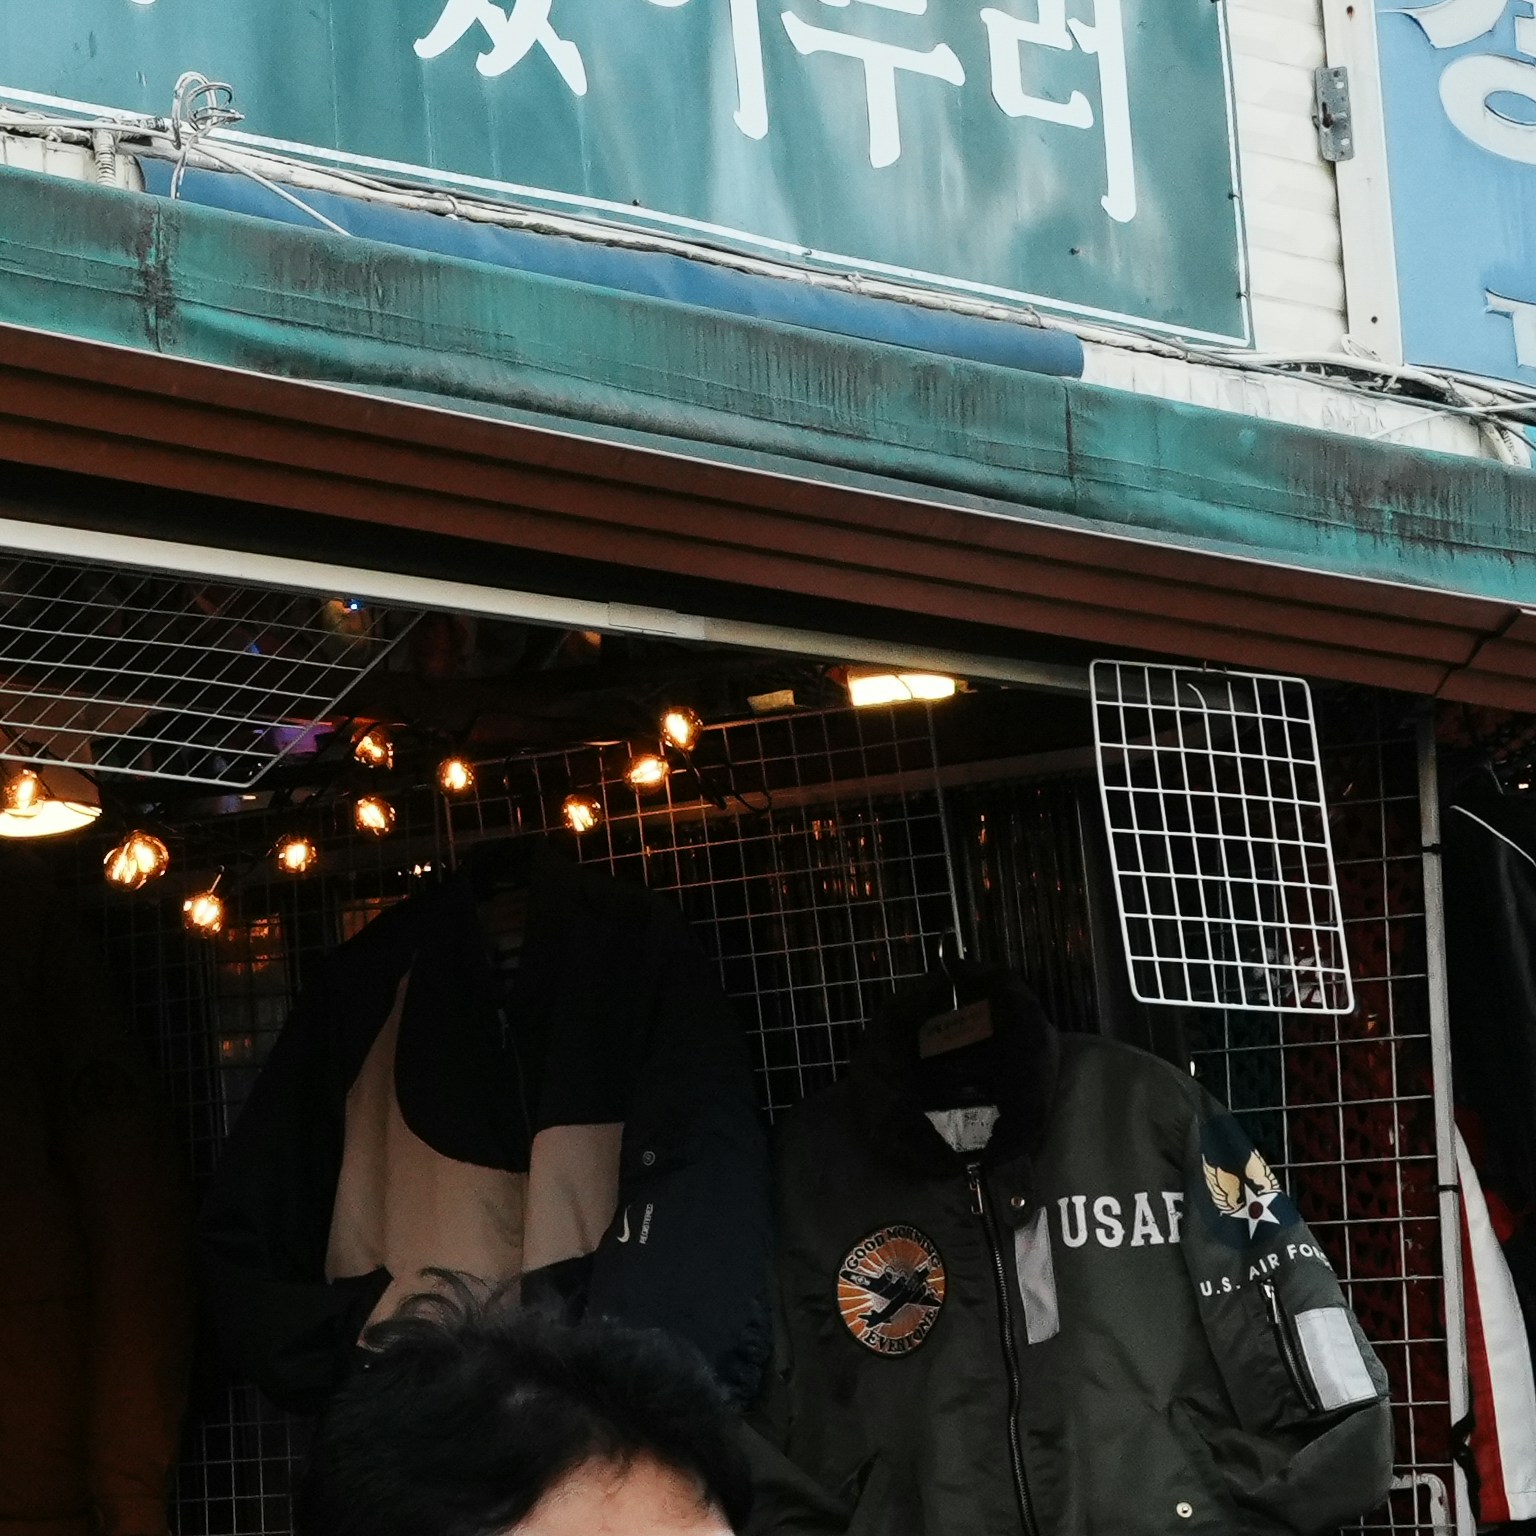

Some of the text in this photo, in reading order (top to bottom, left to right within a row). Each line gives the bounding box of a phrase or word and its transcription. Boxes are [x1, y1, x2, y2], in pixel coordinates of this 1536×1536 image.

[1057, 1191, 1184, 1248] USAF
[846, 1233, 885, 1270] GOOD
[1200, 1276, 1241, 1297] U.S.
[1249, 1252, 1281, 1281] AIR
